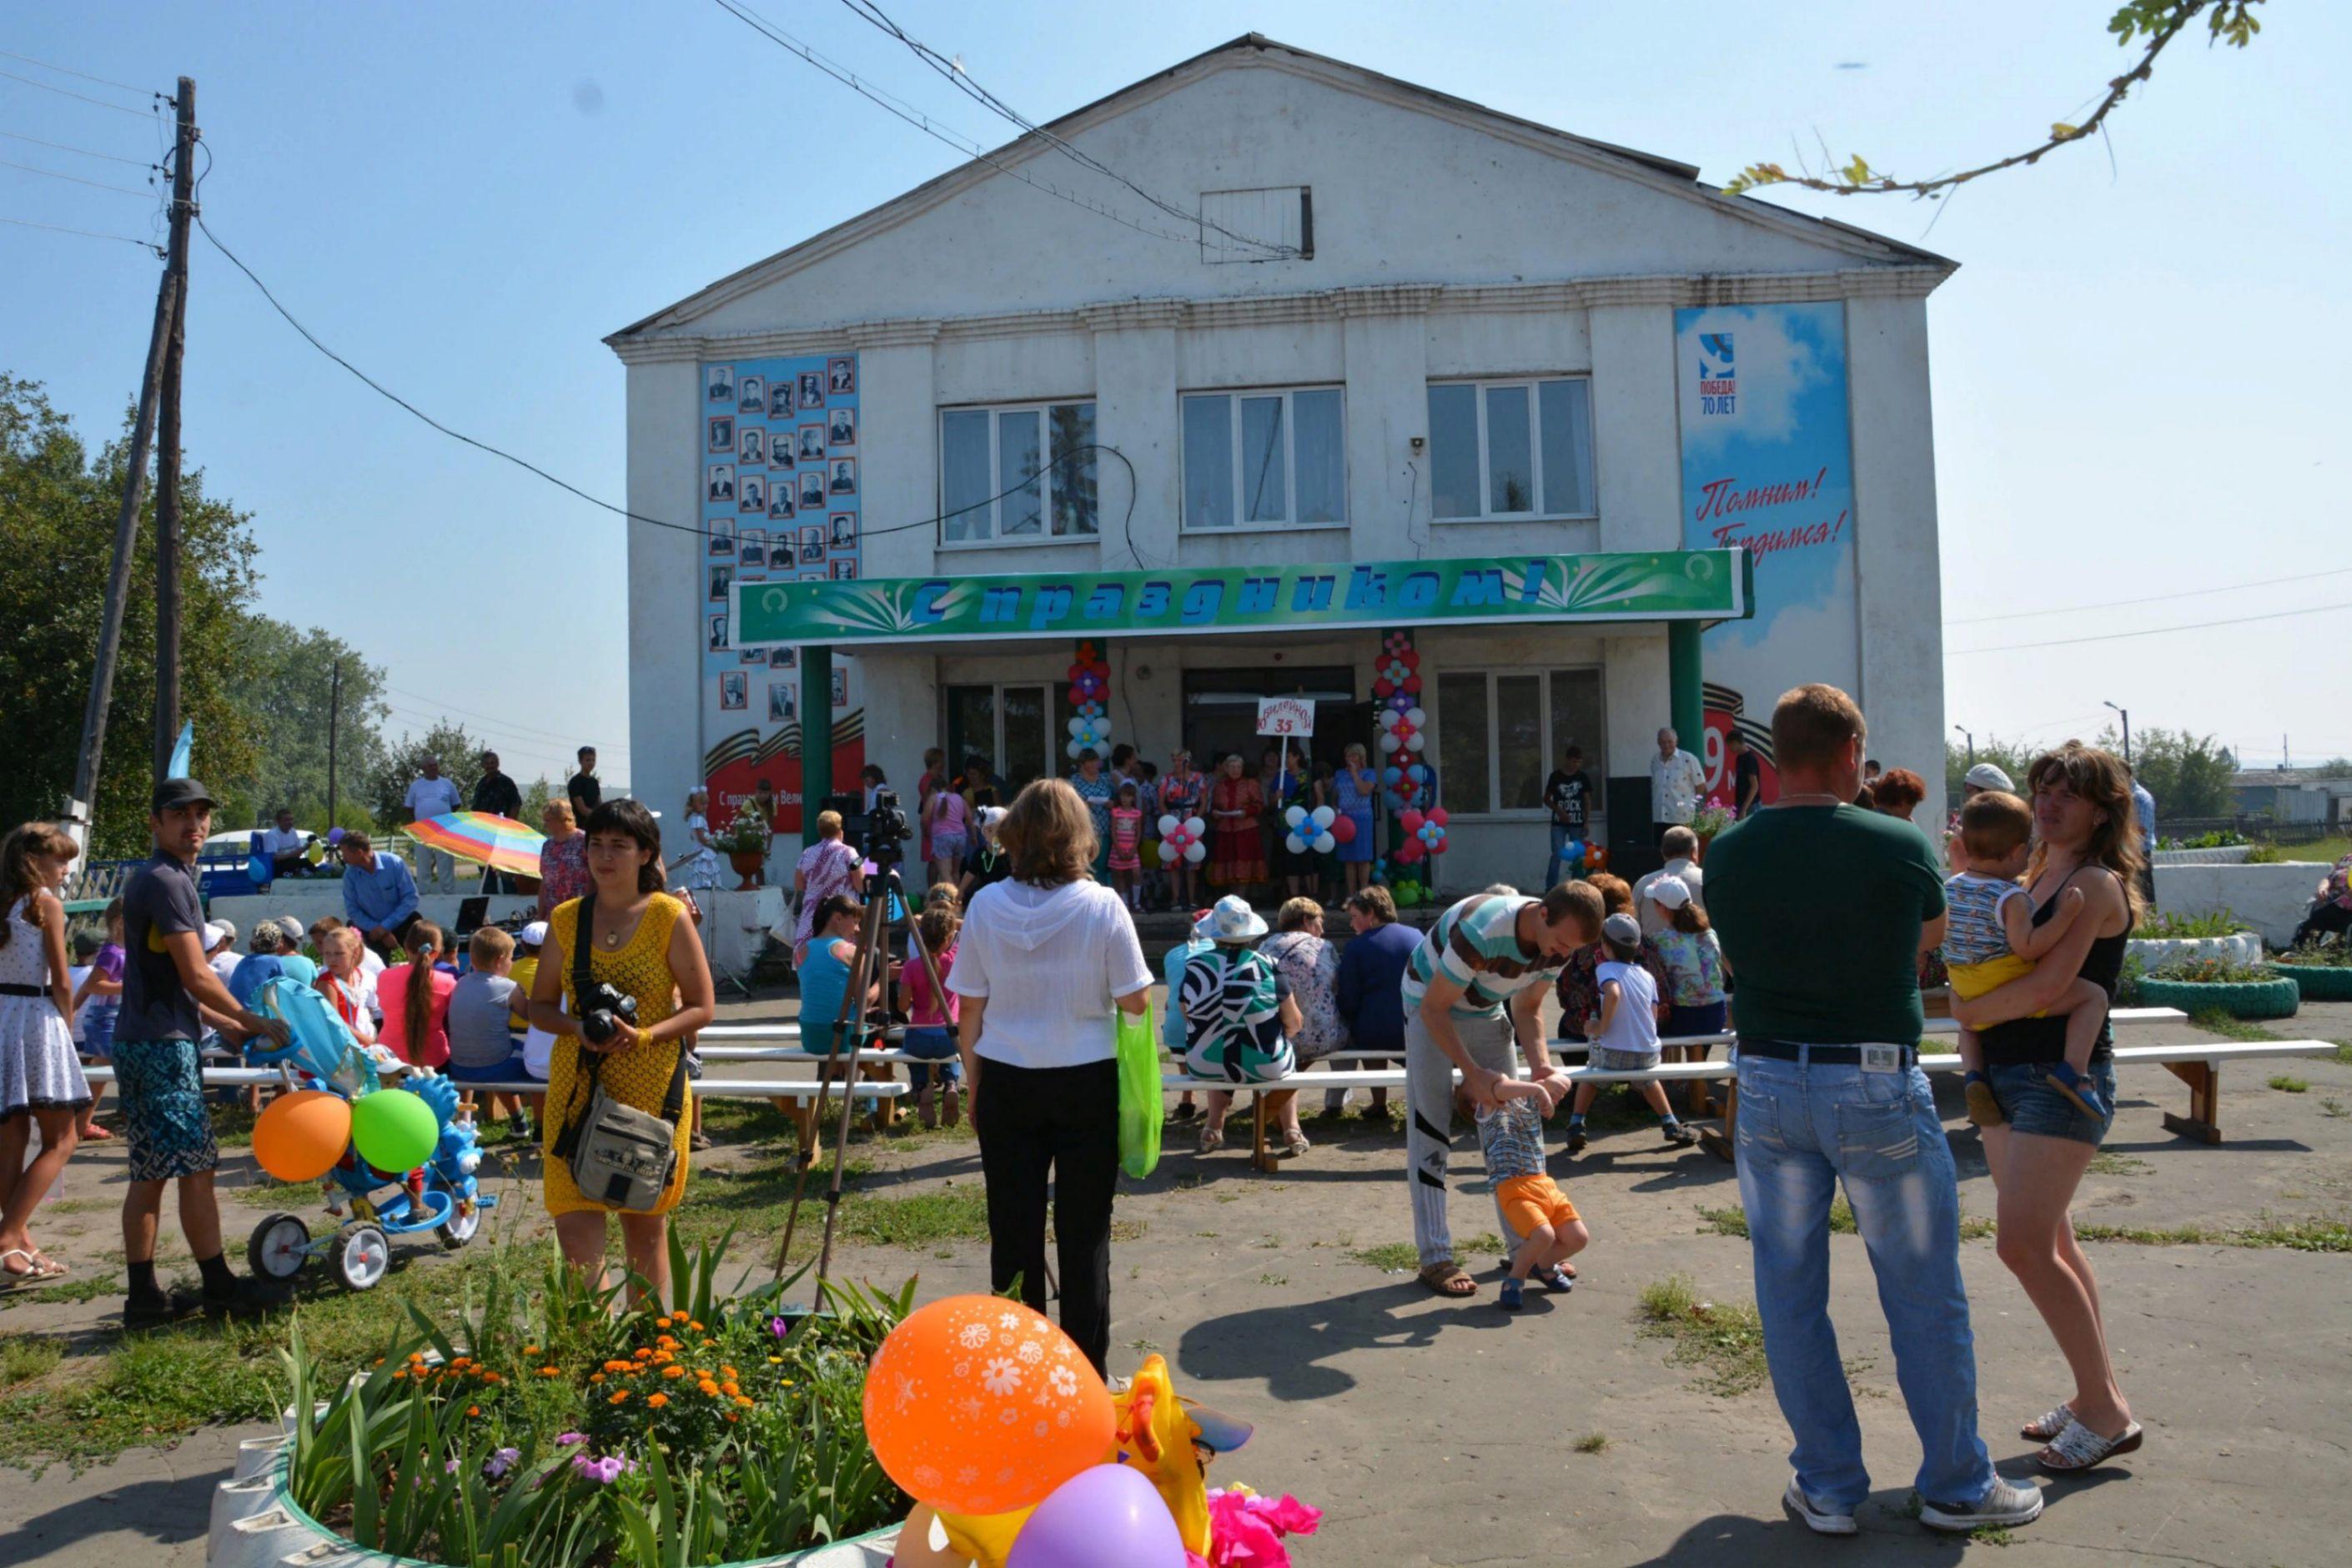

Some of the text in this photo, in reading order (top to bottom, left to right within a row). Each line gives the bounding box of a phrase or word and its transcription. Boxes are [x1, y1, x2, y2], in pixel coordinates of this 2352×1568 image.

[1700, 379, 1736, 395] ПОБЕДА!
[1701, 395, 1736, 415] 70 ЛЕТ
[1696, 467, 1827, 522] Помним!
[979, 560, 1548, 630] праздником!
[1274, 718, 1294, 733] 35
[1704, 726, 1725, 793] 9
